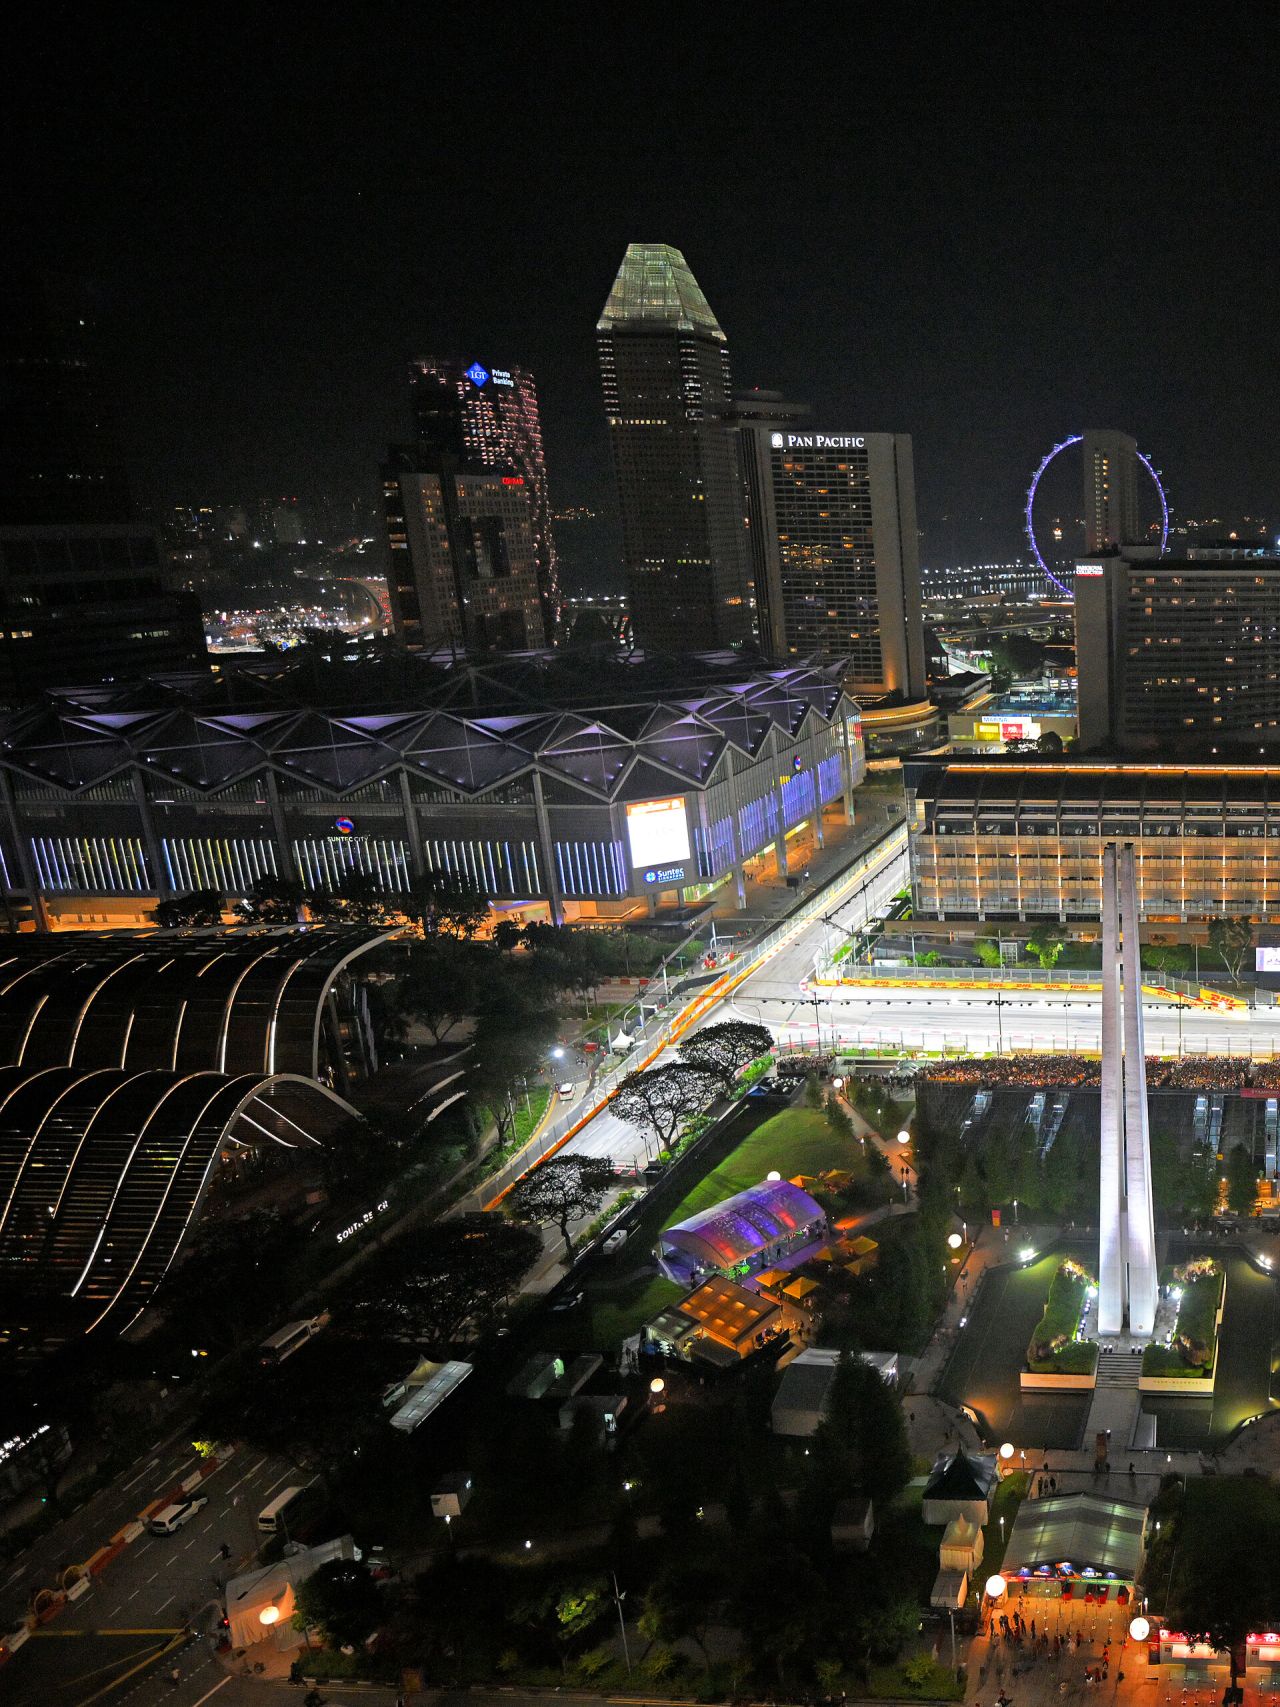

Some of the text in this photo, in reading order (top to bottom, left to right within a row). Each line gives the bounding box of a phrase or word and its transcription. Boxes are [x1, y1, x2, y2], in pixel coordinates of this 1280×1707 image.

[470, 371, 487, 380] LGT
[491, 369, 511, 378] Private
[493, 377, 514, 388] Banking
[787, 435, 865, 448] PAN PACIFIC
[657, 867, 684, 878] Suntec
[363, 1200, 389, 1223] BECH
